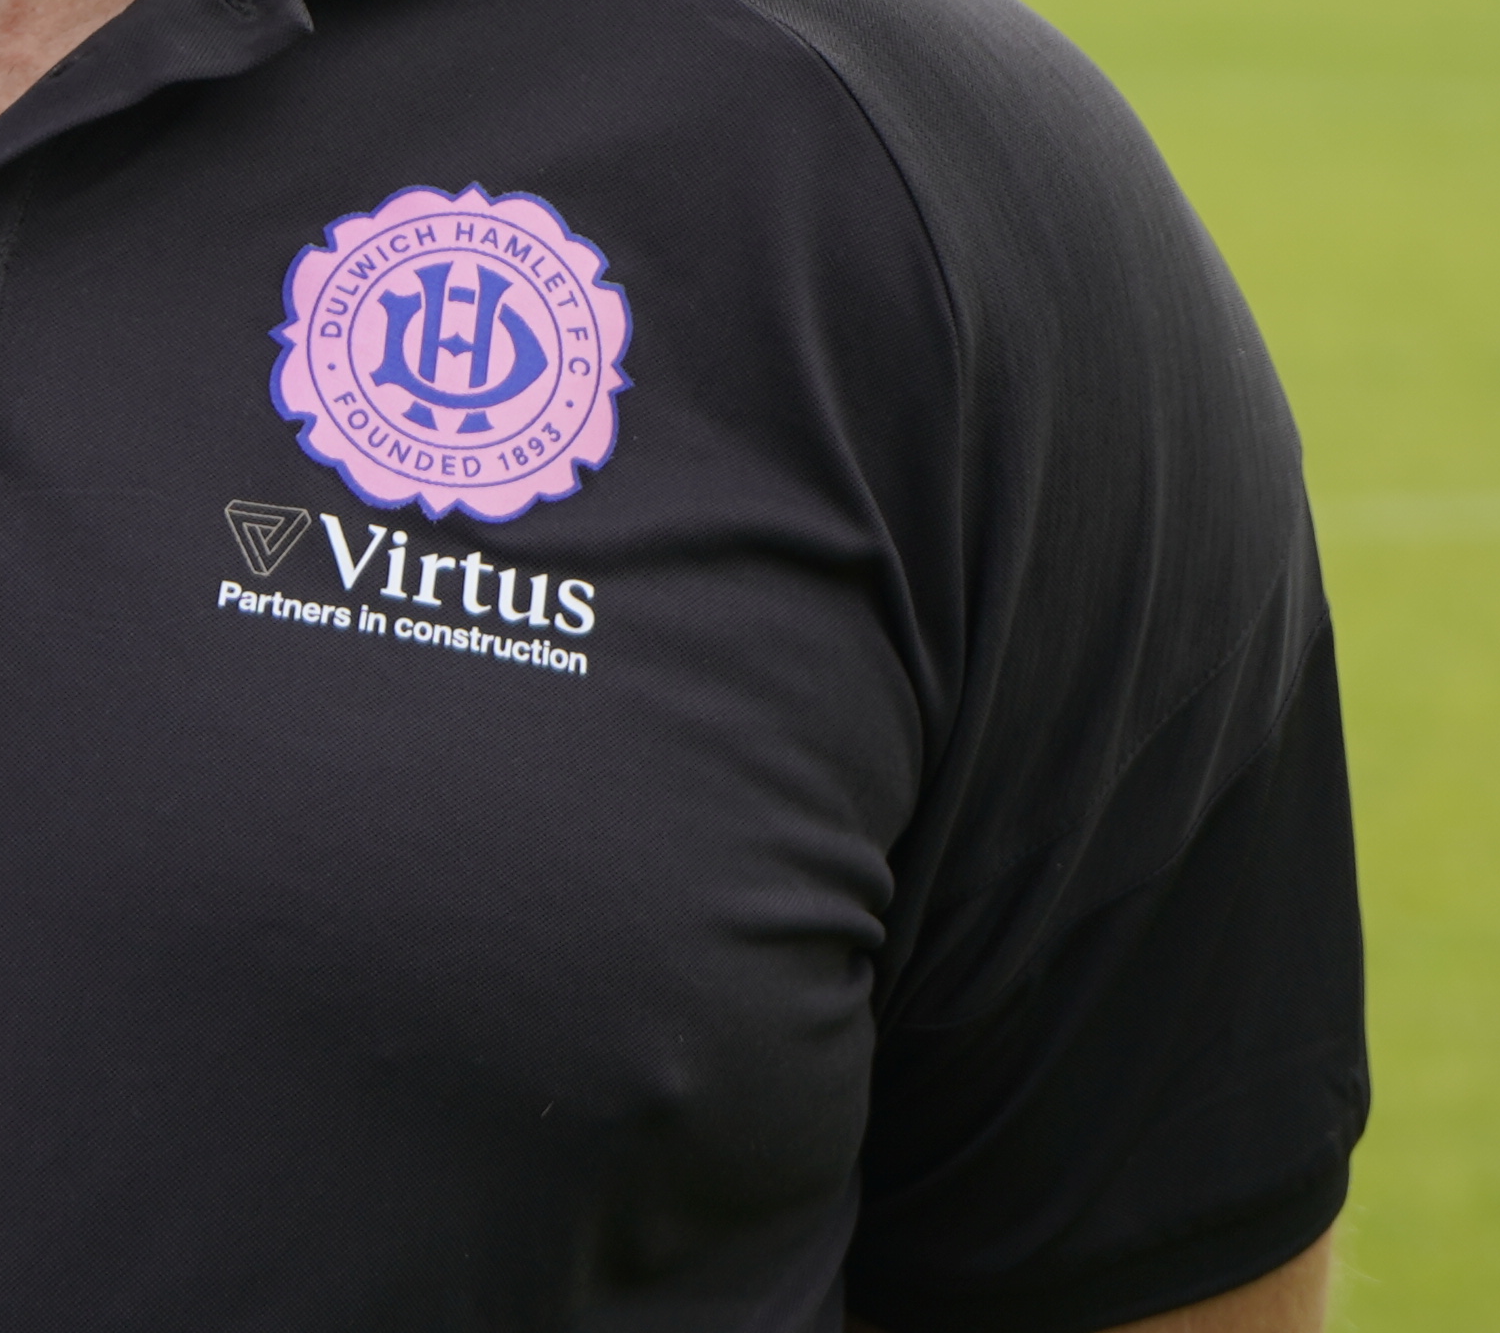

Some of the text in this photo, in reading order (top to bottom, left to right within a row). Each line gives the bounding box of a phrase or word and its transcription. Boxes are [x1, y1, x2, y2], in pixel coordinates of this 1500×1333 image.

[320, 225, 437, 339] DULWICH
[455, 222, 578, 309] HAMLET
[333, 391, 562, 478] FOUNDED 1893
[319, 512, 596, 634] Virtus
[217, 580, 588, 675] Partners in construction
